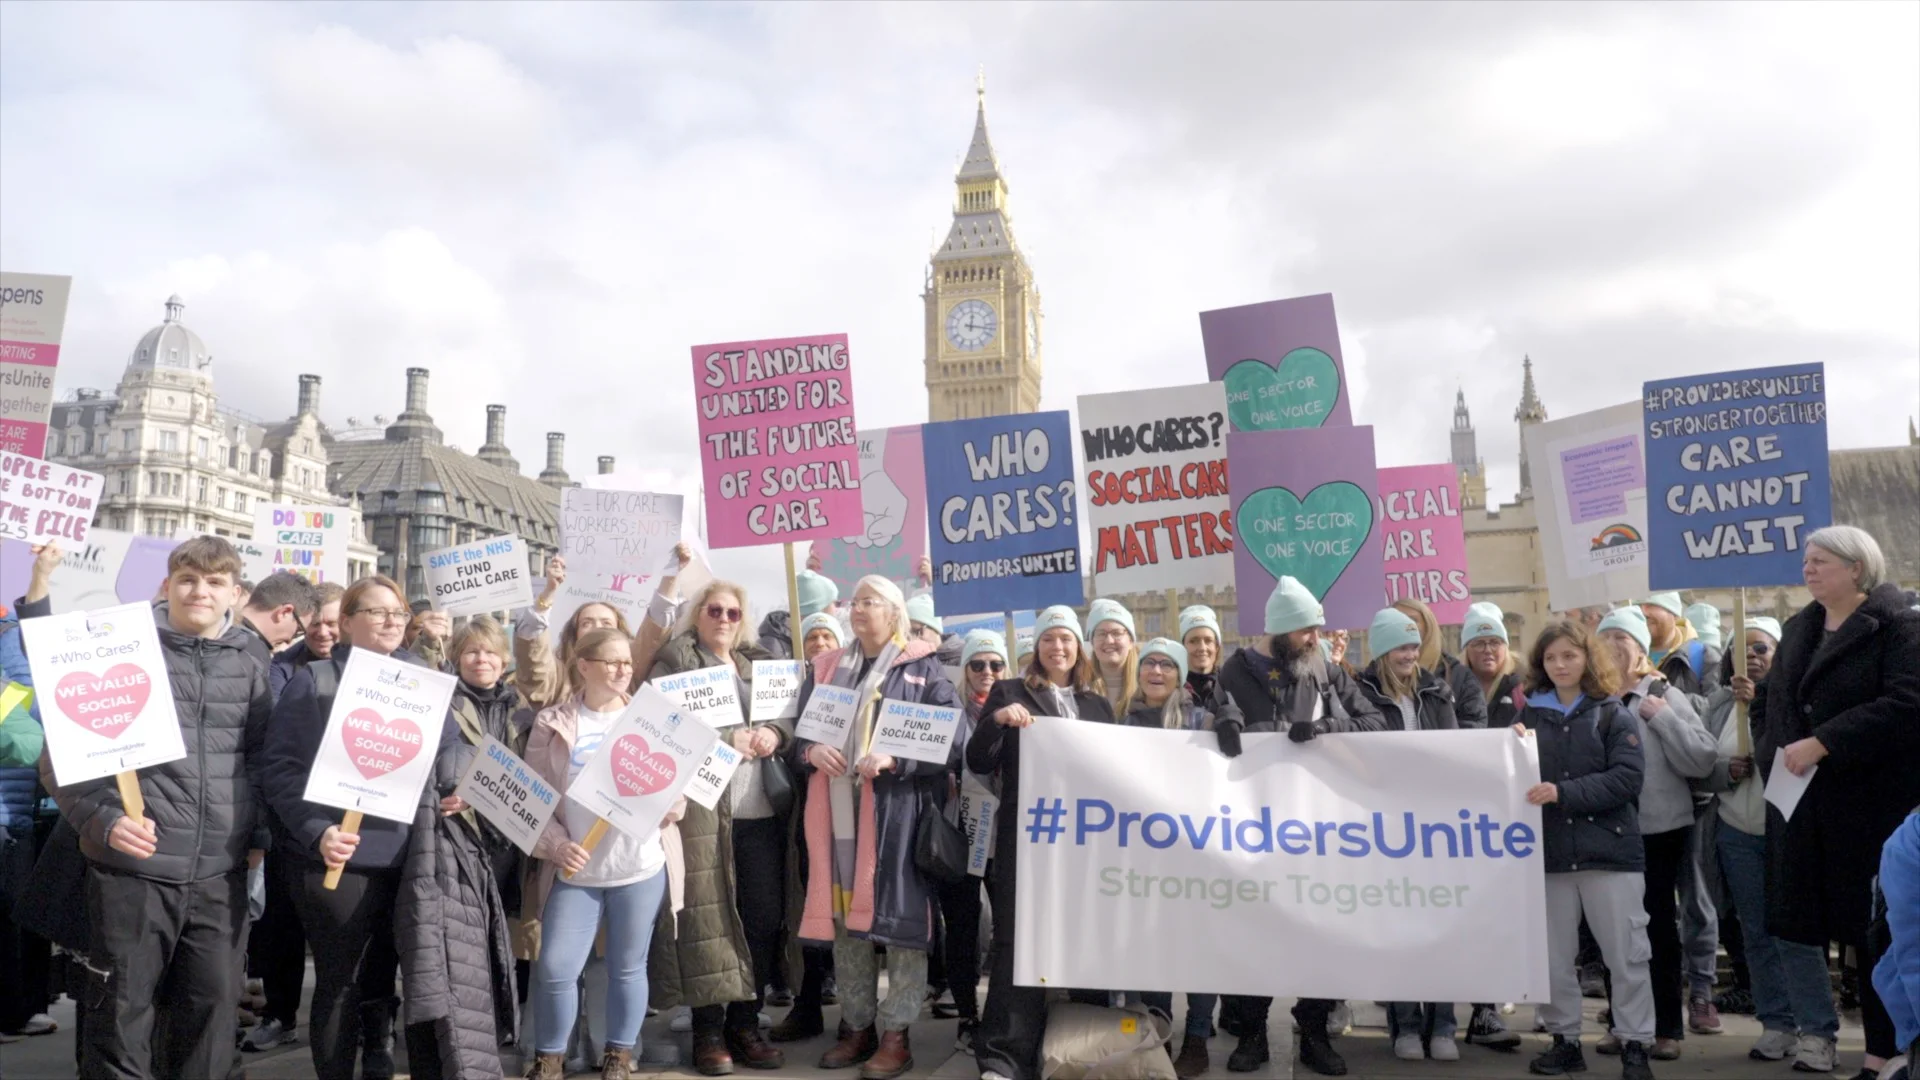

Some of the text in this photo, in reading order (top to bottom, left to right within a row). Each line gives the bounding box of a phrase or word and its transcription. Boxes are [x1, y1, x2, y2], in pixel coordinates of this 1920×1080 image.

[0, 287, 43, 308] pens
[704, 343, 848, 388] STANDING
[702, 378, 849, 420] UNITED FOR
[1227, 376, 1318, 404] ONE SECTOR
[1646, 373, 1823, 412] #PROVIDERSUNITE
[0, 396, 48, 414] gether
[1251, 400, 1323, 426] ONE VOICE
[5, 426, 28, 440] ARE
[706, 416, 856, 460] THE FUTURE
[963, 428, 1050, 482] WHO
[1680, 434, 1782, 472] CARE
[0, 456, 93, 488] OPLE AT
[719, 459, 860, 500] OF SOCIAL
[22, 483, 92, 510] BOTTOM
[596, 491, 620, 513] FOR
[625, 493, 661, 514] CARE
[1666, 472, 1809, 515] CANNOT
[35, 509, 88, 542] PILE
[273, 510, 295, 526] DO
[747, 497, 828, 536] CARE
[940, 480, 1076, 545] CARES?
[1253, 512, 1357, 533] ONE SECTOR
[278, 531, 322, 546] CARE
[564, 515, 672, 537] WORKERS NOT
[1682, 515, 1805, 561] WAIT
[429, 540, 512, 569] SAVE the NHS
[564, 536, 648, 556] FOR TAX!
[1095, 510, 1233, 575] MATTERS
[1265, 538, 1353, 558] ONE VOICE
[1383, 528, 1438, 561] ARE
[274, 548, 324, 566] ABOUT
[456, 561, 491, 578] FUND
[932, 549, 1076, 585] #PROVIDERSUNITE
[1603, 554, 1635, 566] GROUP
[435, 577, 482, 596] SOCIAL
[485, 568, 519, 585] CARE
[1384, 569, 1470, 607] TTERS
[565, 586, 602, 600] Ashwell
[605, 593, 633, 606] Home
[96, 640, 140, 658] Cares?
[660, 670, 730, 692] SAVE the NHS
[757, 663, 800, 676] SAVE the NHS
[768, 678, 786, 687] FUND
[57, 672, 147, 699] WE VALUE
[684, 686, 714, 700] FUND
[755, 688, 797, 700] SOCIAL CARE
[77, 694, 136, 714] SOCIAL
[355, 686, 432, 715] #Who Cares?
[709, 695, 735, 708] CARE
[817, 701, 835, 713] FUND
[888, 703, 955, 722] SAVE the NHS
[91, 711, 133, 729] CARE
[347, 716, 421, 745] WE VALUE
[803, 710, 823, 722] SOCIAL
[824, 714, 846, 729] CARE
[903, 720, 931, 731] FUND
[354, 737, 402, 758] SOCIAL
[634, 715, 660, 738] #Who
[661, 734, 693, 758] Cares?
[881, 727, 916, 740] SOCIAL
[920, 732, 948, 745] CARE
[357, 755, 393, 772] CARE
[618, 737, 675, 781] WE VALUE
[714, 745, 735, 765] NHS
[487, 744, 553, 805] SAVE the NHS
[616, 773, 645, 796] CARE
[619, 757, 655, 786] SOCIAL
[697, 767, 722, 788] CARE
[473, 770, 509, 806] SOCIAL
[511, 802, 540, 830] CARE
[500, 773, 527, 802] FUND
[967, 817, 978, 846] FUND
[972, 800, 992, 869] SAVE the NHS
[1025, 797, 1536, 859] #ProvidersUnite
[1099, 865, 1470, 915] Stronger Together
